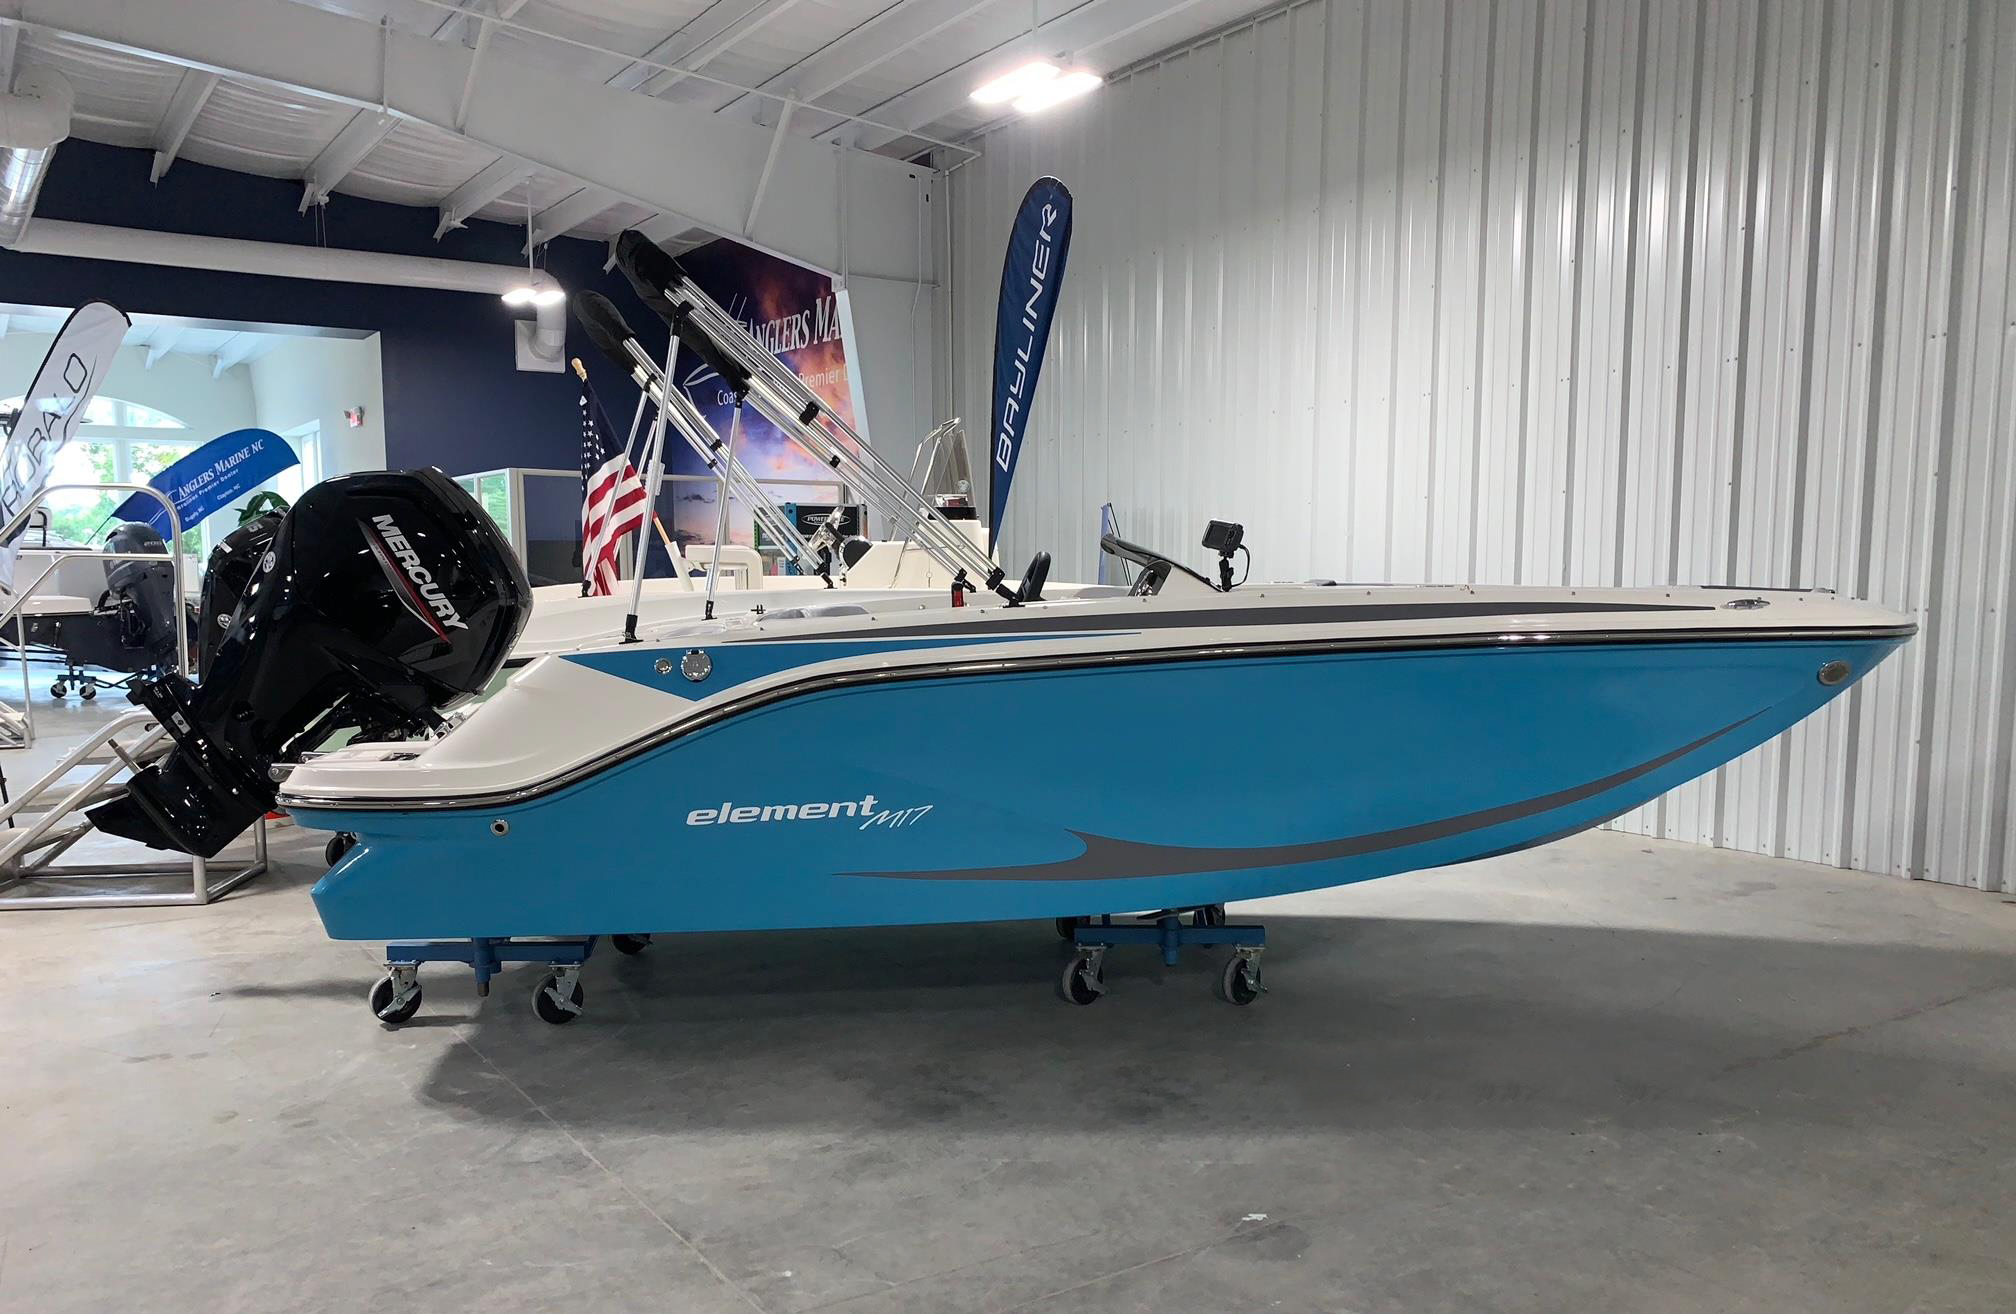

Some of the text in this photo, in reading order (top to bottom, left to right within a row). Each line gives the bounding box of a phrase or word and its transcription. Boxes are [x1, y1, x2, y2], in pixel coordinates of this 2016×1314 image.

[996, 203, 1057, 473] BAYLINER
[798, 366, 838, 388] Premier
[178, 438, 264, 500] ANGLERS MARINE NC
[372, 514, 469, 630] MERCURY
[686, 795, 934, 830] element M17
